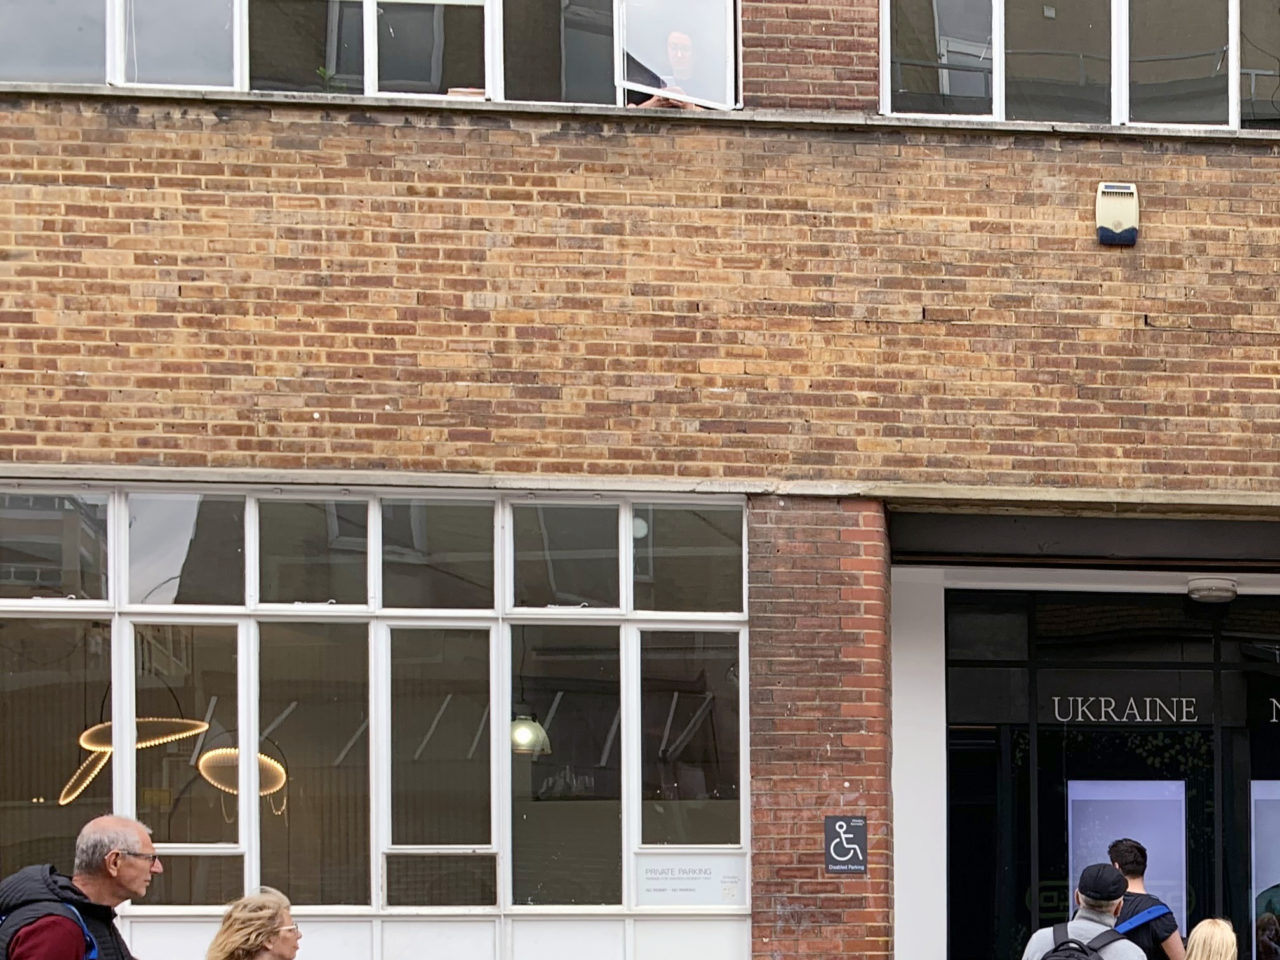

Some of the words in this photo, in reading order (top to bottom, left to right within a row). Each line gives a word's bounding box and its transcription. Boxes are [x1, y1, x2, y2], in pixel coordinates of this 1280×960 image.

[1051, 696, 1199, 722] UKRAINE
[645, 868, 676, 876] PRIVATE
[678, 868, 712, 876] PARKING
